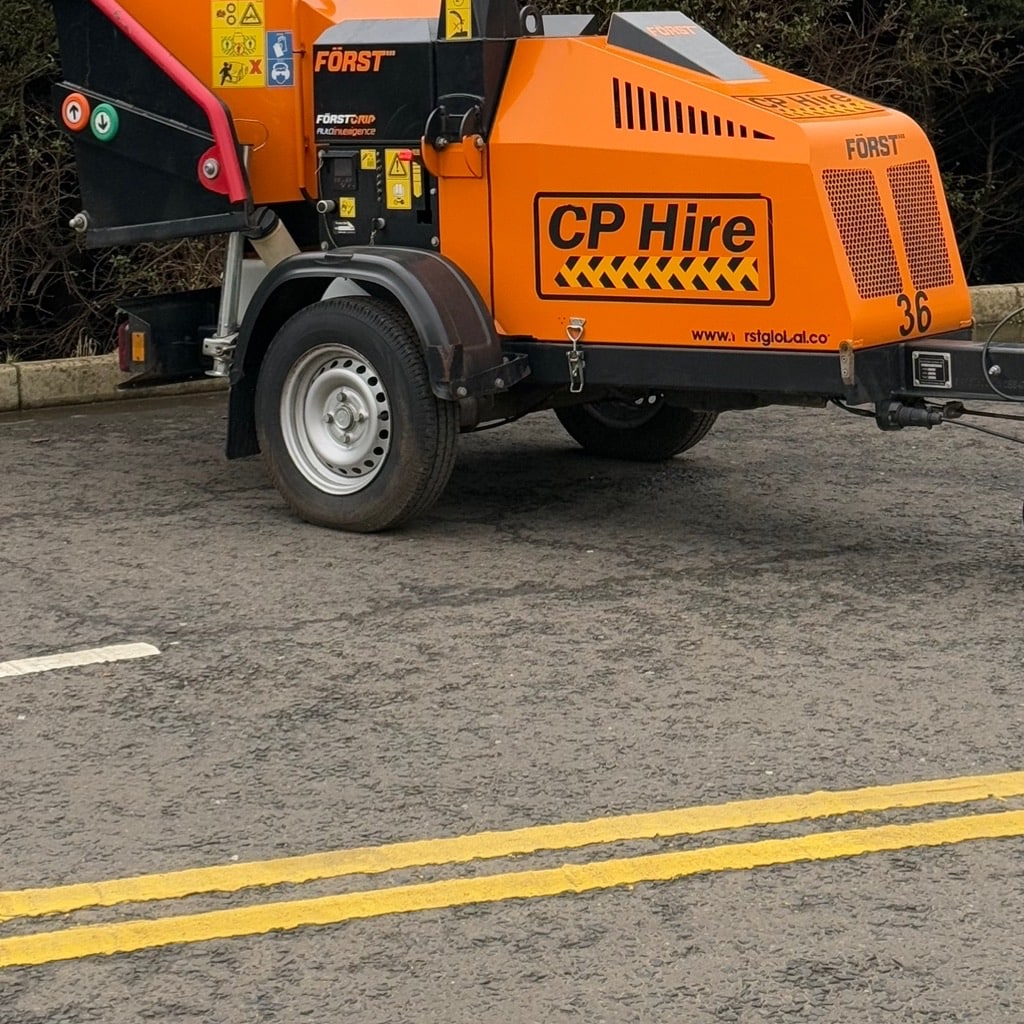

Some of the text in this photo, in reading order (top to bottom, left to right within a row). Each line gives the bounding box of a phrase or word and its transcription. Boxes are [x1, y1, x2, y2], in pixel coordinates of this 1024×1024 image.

[315, 47, 384, 72] FÖRST
[748, 93, 852, 109] CP Hire
[846, 133, 898, 161] FÖRST
[549, 203, 756, 253] CP Hire
[897, 290, 932, 337] 36
